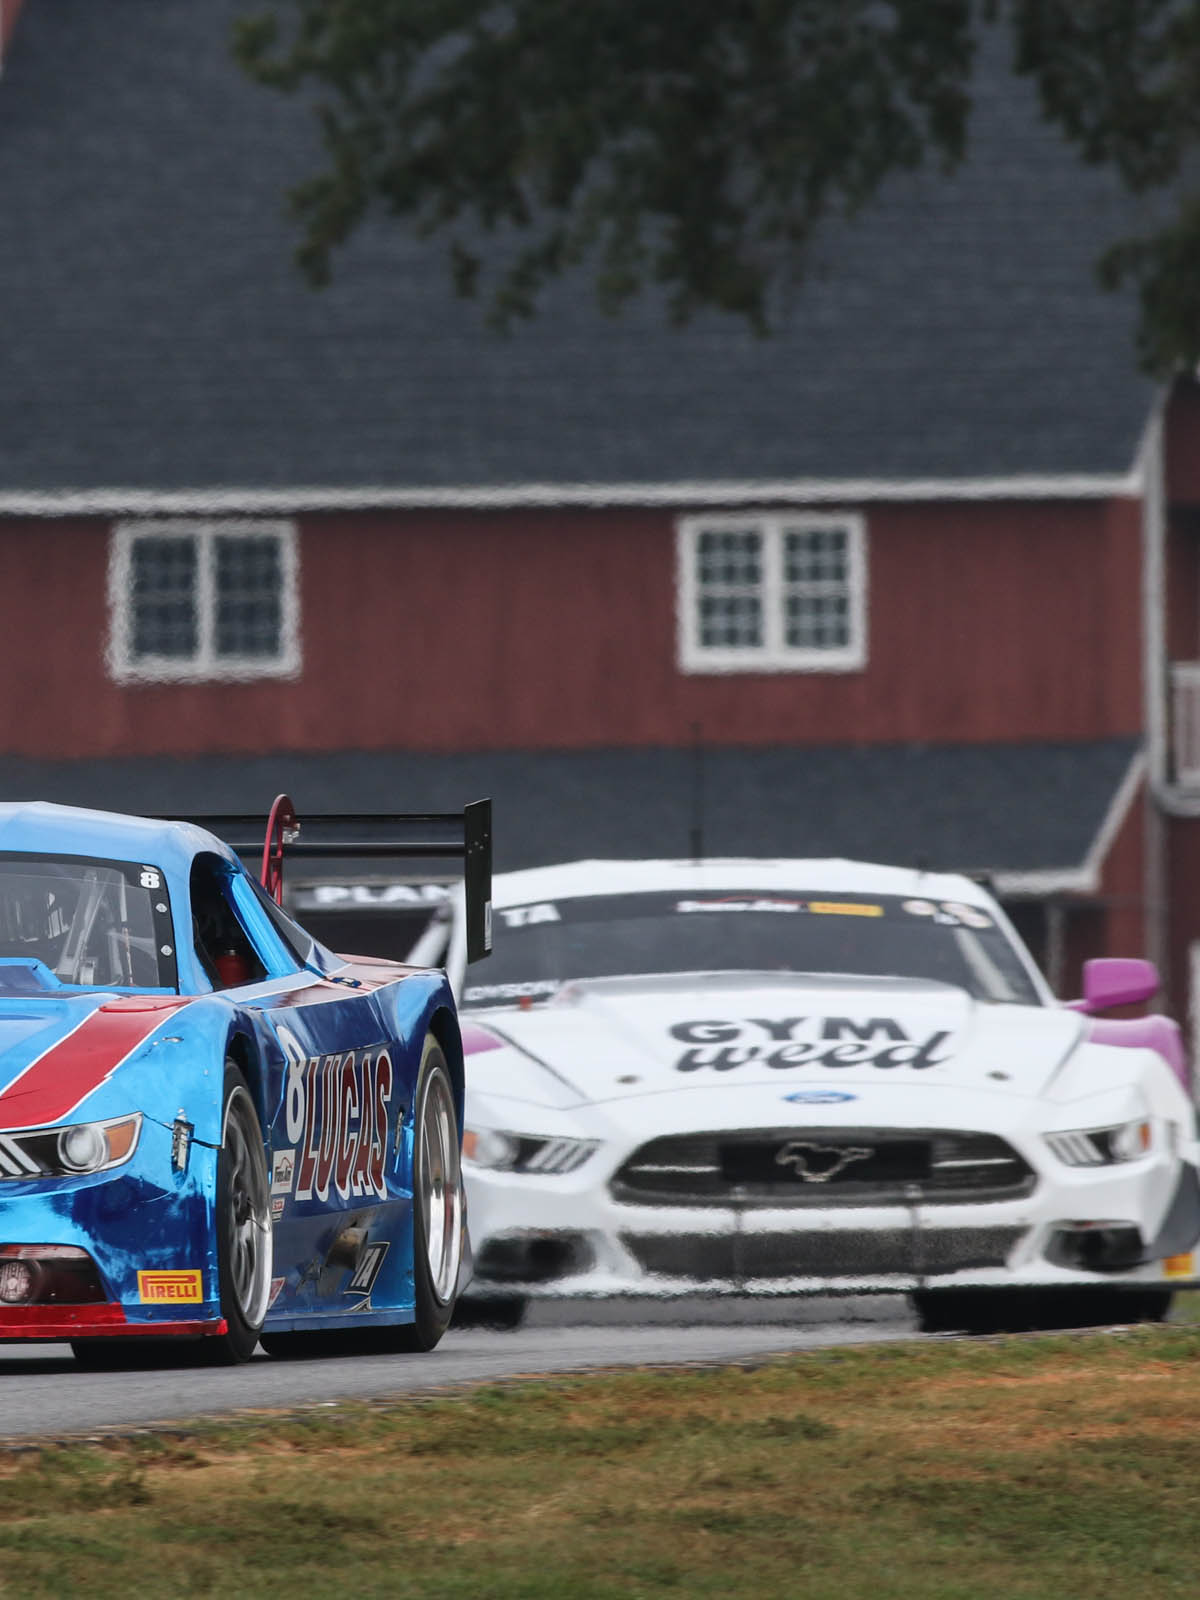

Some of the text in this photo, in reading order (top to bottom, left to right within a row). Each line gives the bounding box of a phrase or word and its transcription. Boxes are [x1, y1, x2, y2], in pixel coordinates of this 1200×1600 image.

[140, 872, 160, 888] 8
[499, 903, 562, 928] TA
[667, 1016, 910, 1045] GYM
[674, 1030, 954, 1073] weed
[276, 1025, 306, 1144] 8
[295, 1049, 393, 1201] LUCAS
[141, 1275, 197, 1298] PIRELLI
